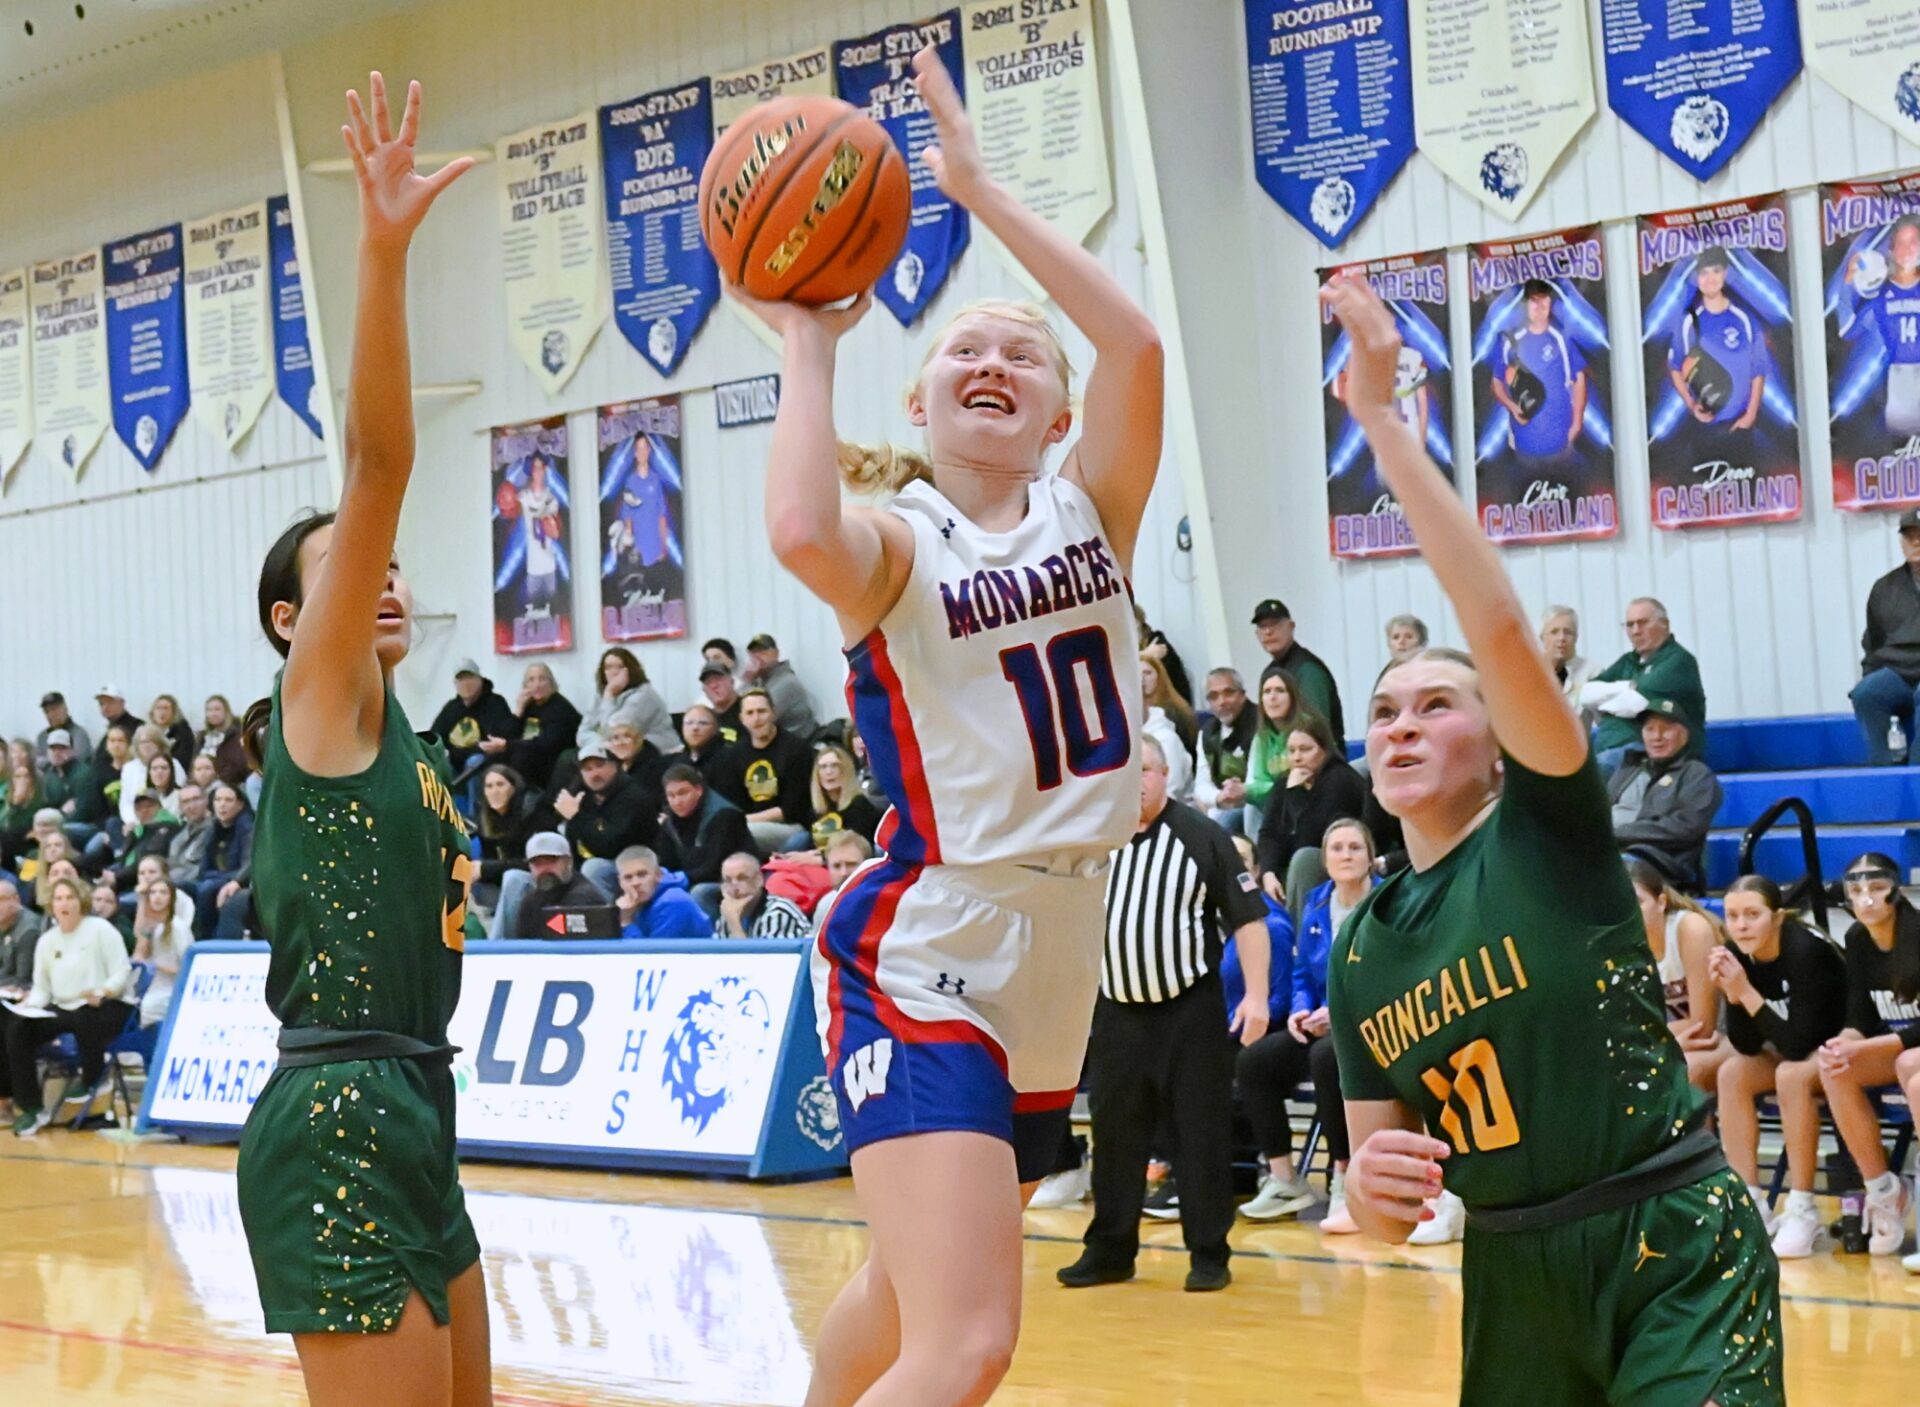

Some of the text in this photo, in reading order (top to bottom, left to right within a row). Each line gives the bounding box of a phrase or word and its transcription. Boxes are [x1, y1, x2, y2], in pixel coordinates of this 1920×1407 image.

[972, 6, 1014, 31] 2021
[1269, 15, 1383, 56] RUNNER-UP
[1272, 0, 1373, 30] FOOTBALL
[885, 20, 951, 56] STATE
[764, 51, 827, 87] STATE
[635, 142, 675, 172] BOYS
[623, 166, 693, 196] FOOTBALL
[1641, 208, 1786, 276] MONARCHS
[1470, 239, 1602, 302] MONARCHS
[1901, 315, 1918, 344] 14
[1522, 479, 1568, 509] Chris
[1692, 460, 1755, 490] Dean
[1483, 494, 1615, 538] CASTELLANO
[1657, 474, 1799, 522] CASTELLANO
[999, 625, 1131, 791] 10
[1359, 935, 1528, 1069] RONCALLI
[475, 980, 594, 1087] LB
[162, 1056, 277, 1105] MONARC
[843, 1038, 893, 1113] W
[1421, 1038, 1520, 1154] 10
